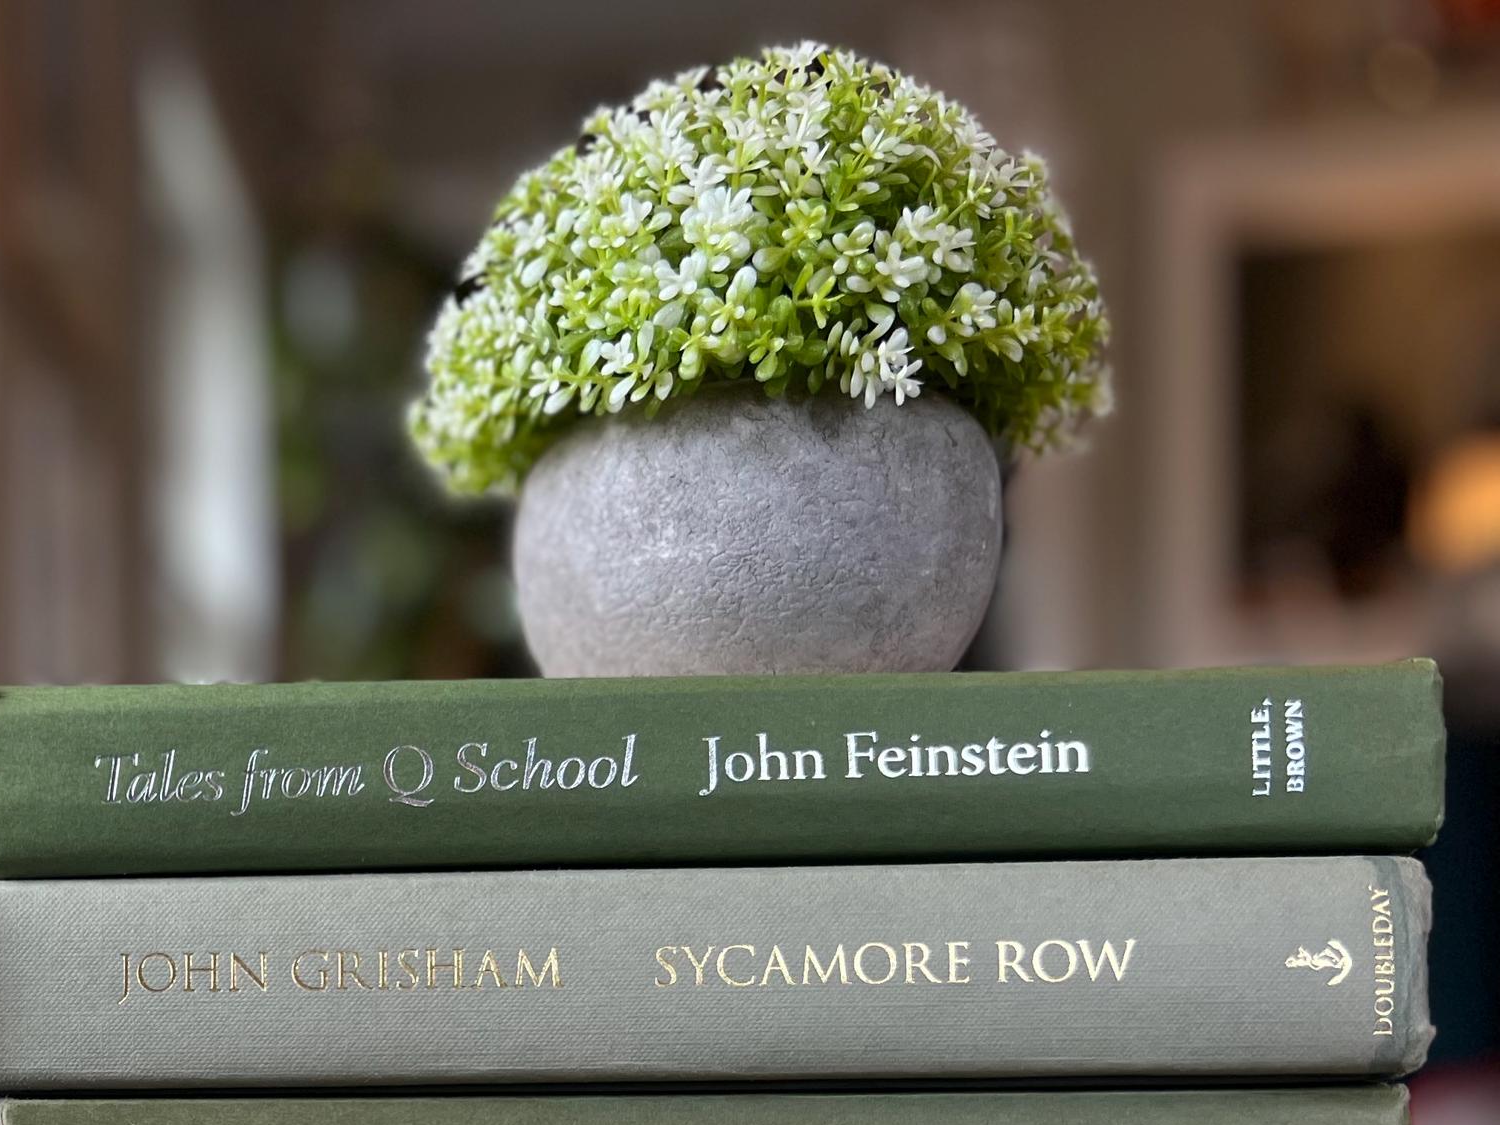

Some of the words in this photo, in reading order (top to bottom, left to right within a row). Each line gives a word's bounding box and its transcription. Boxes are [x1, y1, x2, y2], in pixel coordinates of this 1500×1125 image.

[95, 749, 225, 806] Tales
[231, 748, 366, 817] from
[382, 744, 436, 808] Q
[454, 733, 639, 793] School
[699, 735, 827, 797] John
[844, 729, 1091, 781] Feinstein
[1251, 697, 1274, 797] LITTLE,
[1285, 698, 1307, 793] BROWN
[118, 950, 270, 1006] JOHN
[291, 945, 564, 993] GRISHAM
[653, 940, 971, 989] SYCAMORE
[996, 936, 1138, 985] ROW
[1371, 887, 1394, 1037] DOUBLEDAY
